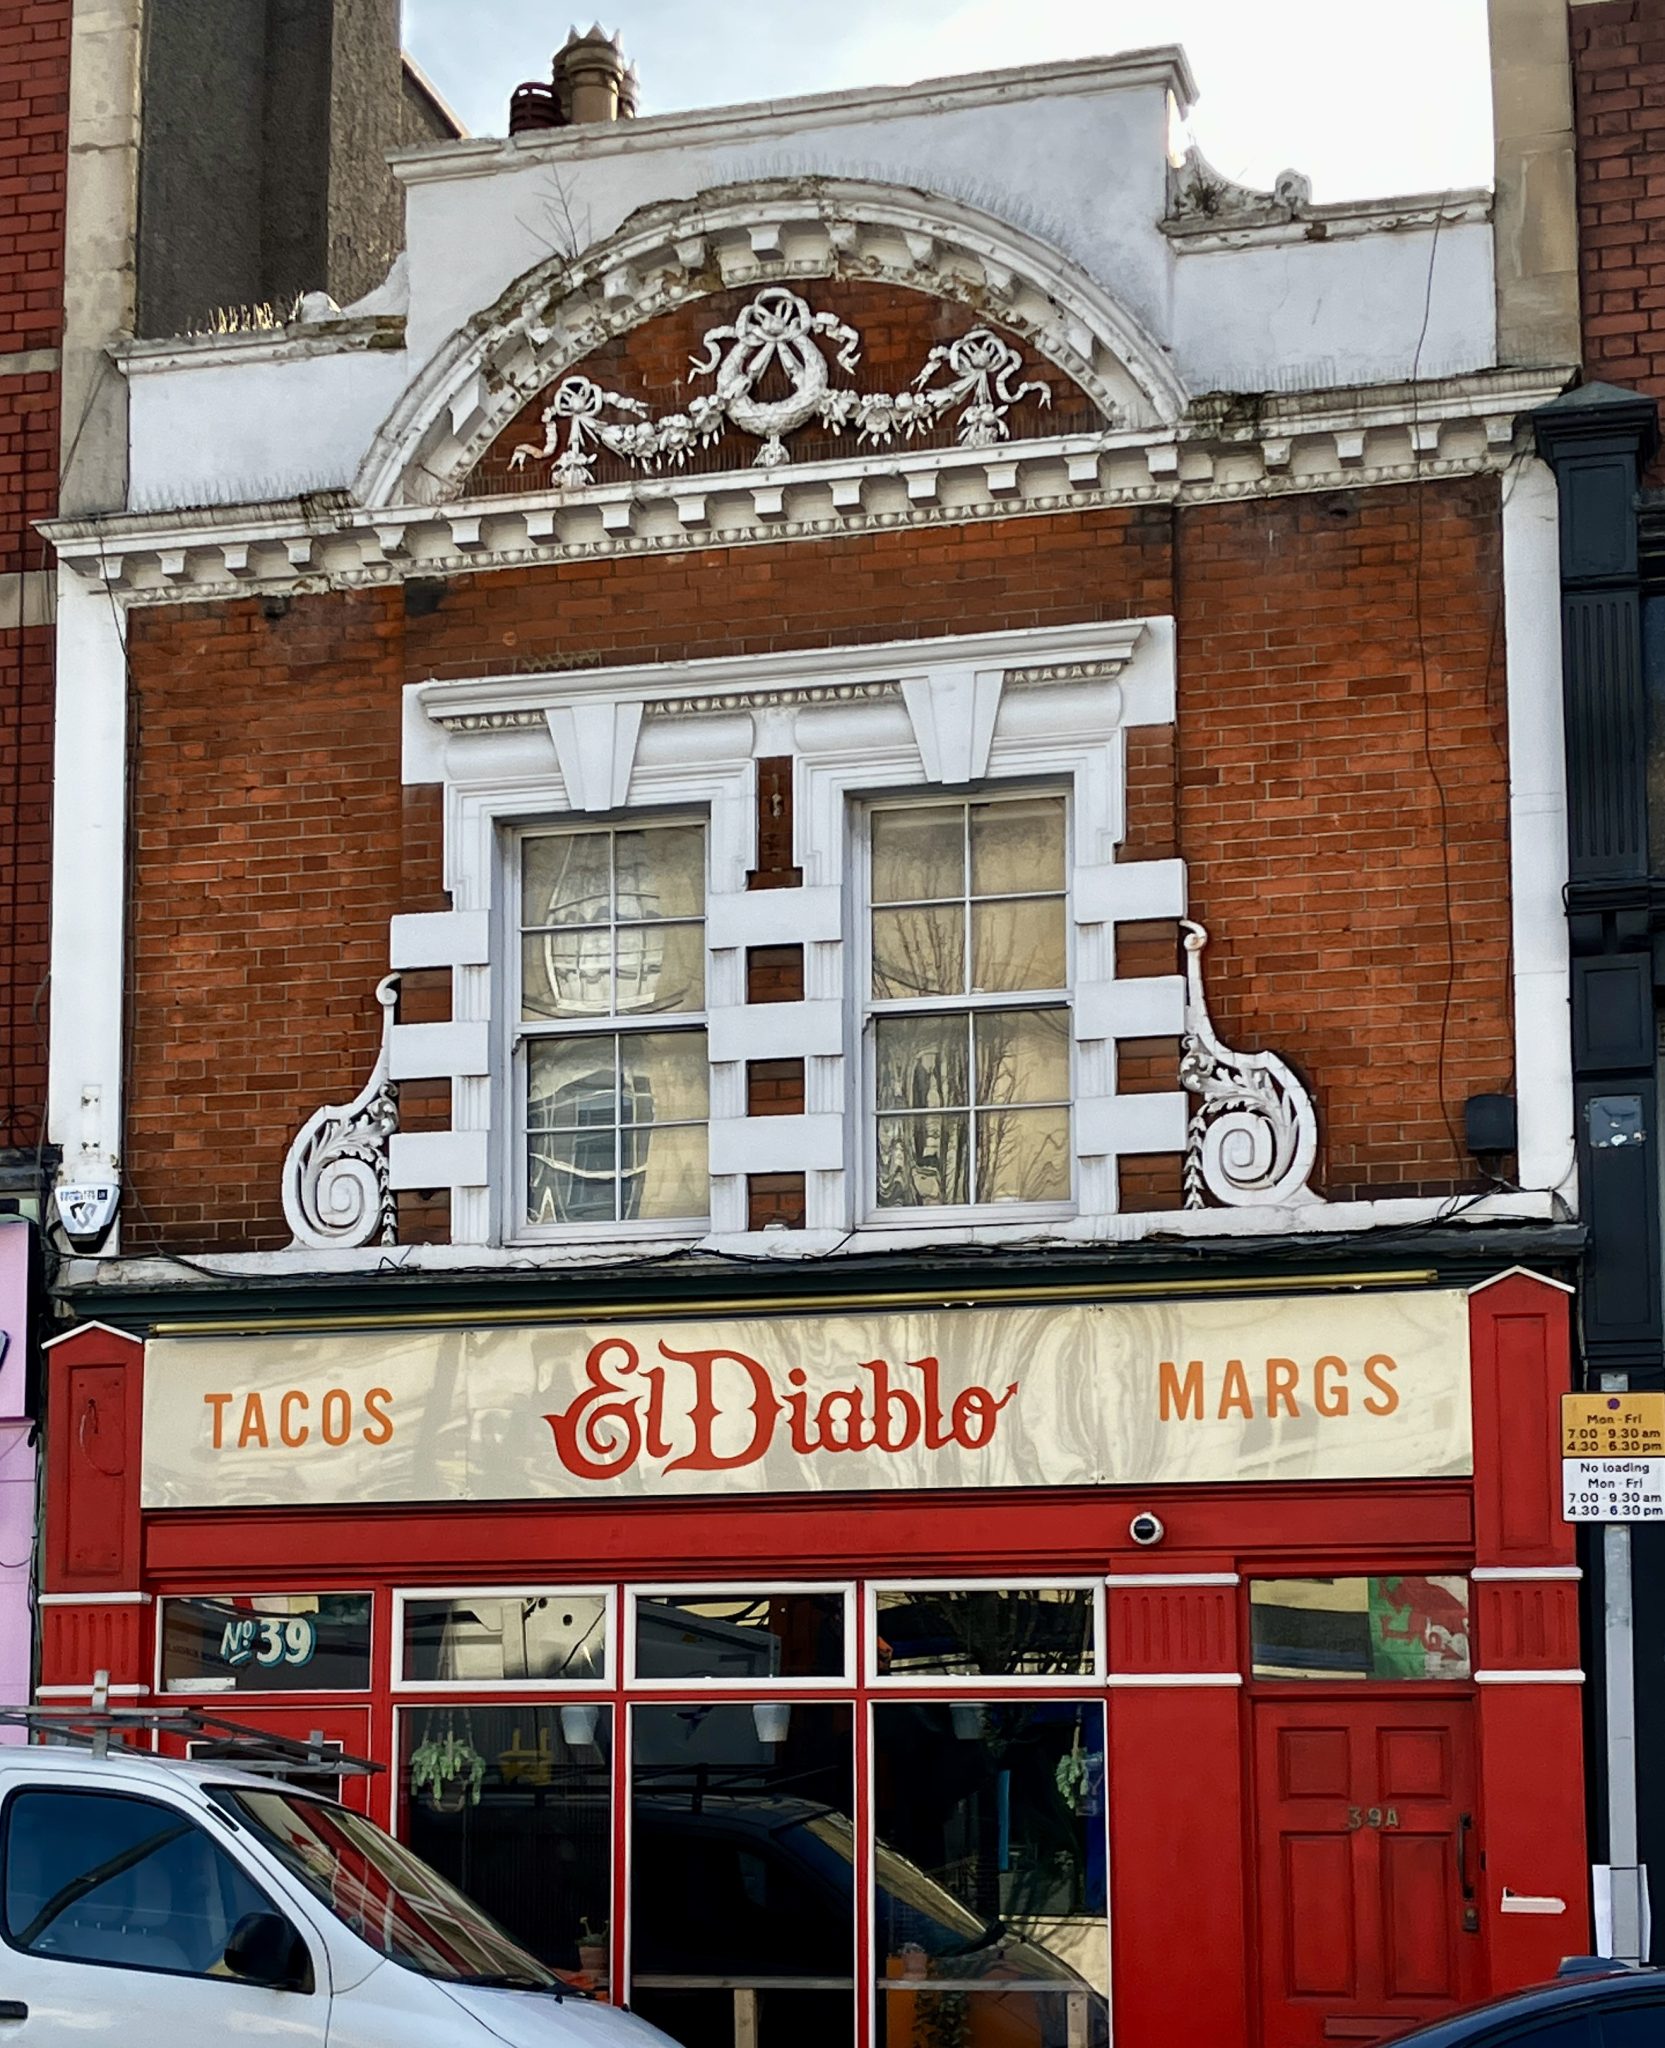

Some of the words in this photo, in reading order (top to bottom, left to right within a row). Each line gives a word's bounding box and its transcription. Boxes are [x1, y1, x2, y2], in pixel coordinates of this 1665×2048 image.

[1159, 1353, 1400, 1421] MARGS
[541, 1337, 674, 1481] El
[658, 1338, 1020, 1478] Diablo
[203, 1387, 394, 1449] TACOS
[1587, 1414, 1615, 1424] Mon
[1624, 1413, 1642, 1424] Fri
[1567, 1428, 1598, 1439] 7.00
[1608, 1428, 1639, 1439] 9.30
[1641, 1429, 1661, 1438] am
[1566, 1441, 1599, 1451] 4.30
[1608, 1441, 1640, 1451] 6.30
[1642, 1442, 1662, 1452] pm
[1580, 1462, 1599, 1473] No
[1602, 1462, 1650, 1474] loading
[1588, 1478, 1615, 1488] Mon
[1626, 1478, 1643, 1488] Fri
[1568, 1492, 1599, 1503] 7.00
[1609, 1492, 1640, 1503] 9.30
[1642, 1494, 1662, 1503] am
[1567, 1505, 1600, 1515] 4.30
[1609, 1505, 1641, 1515] 6.30
[1643, 1507, 1663, 1517] pm
[256, 1616, 318, 1667] 39
[1347, 1807, 1399, 1829] 39A
